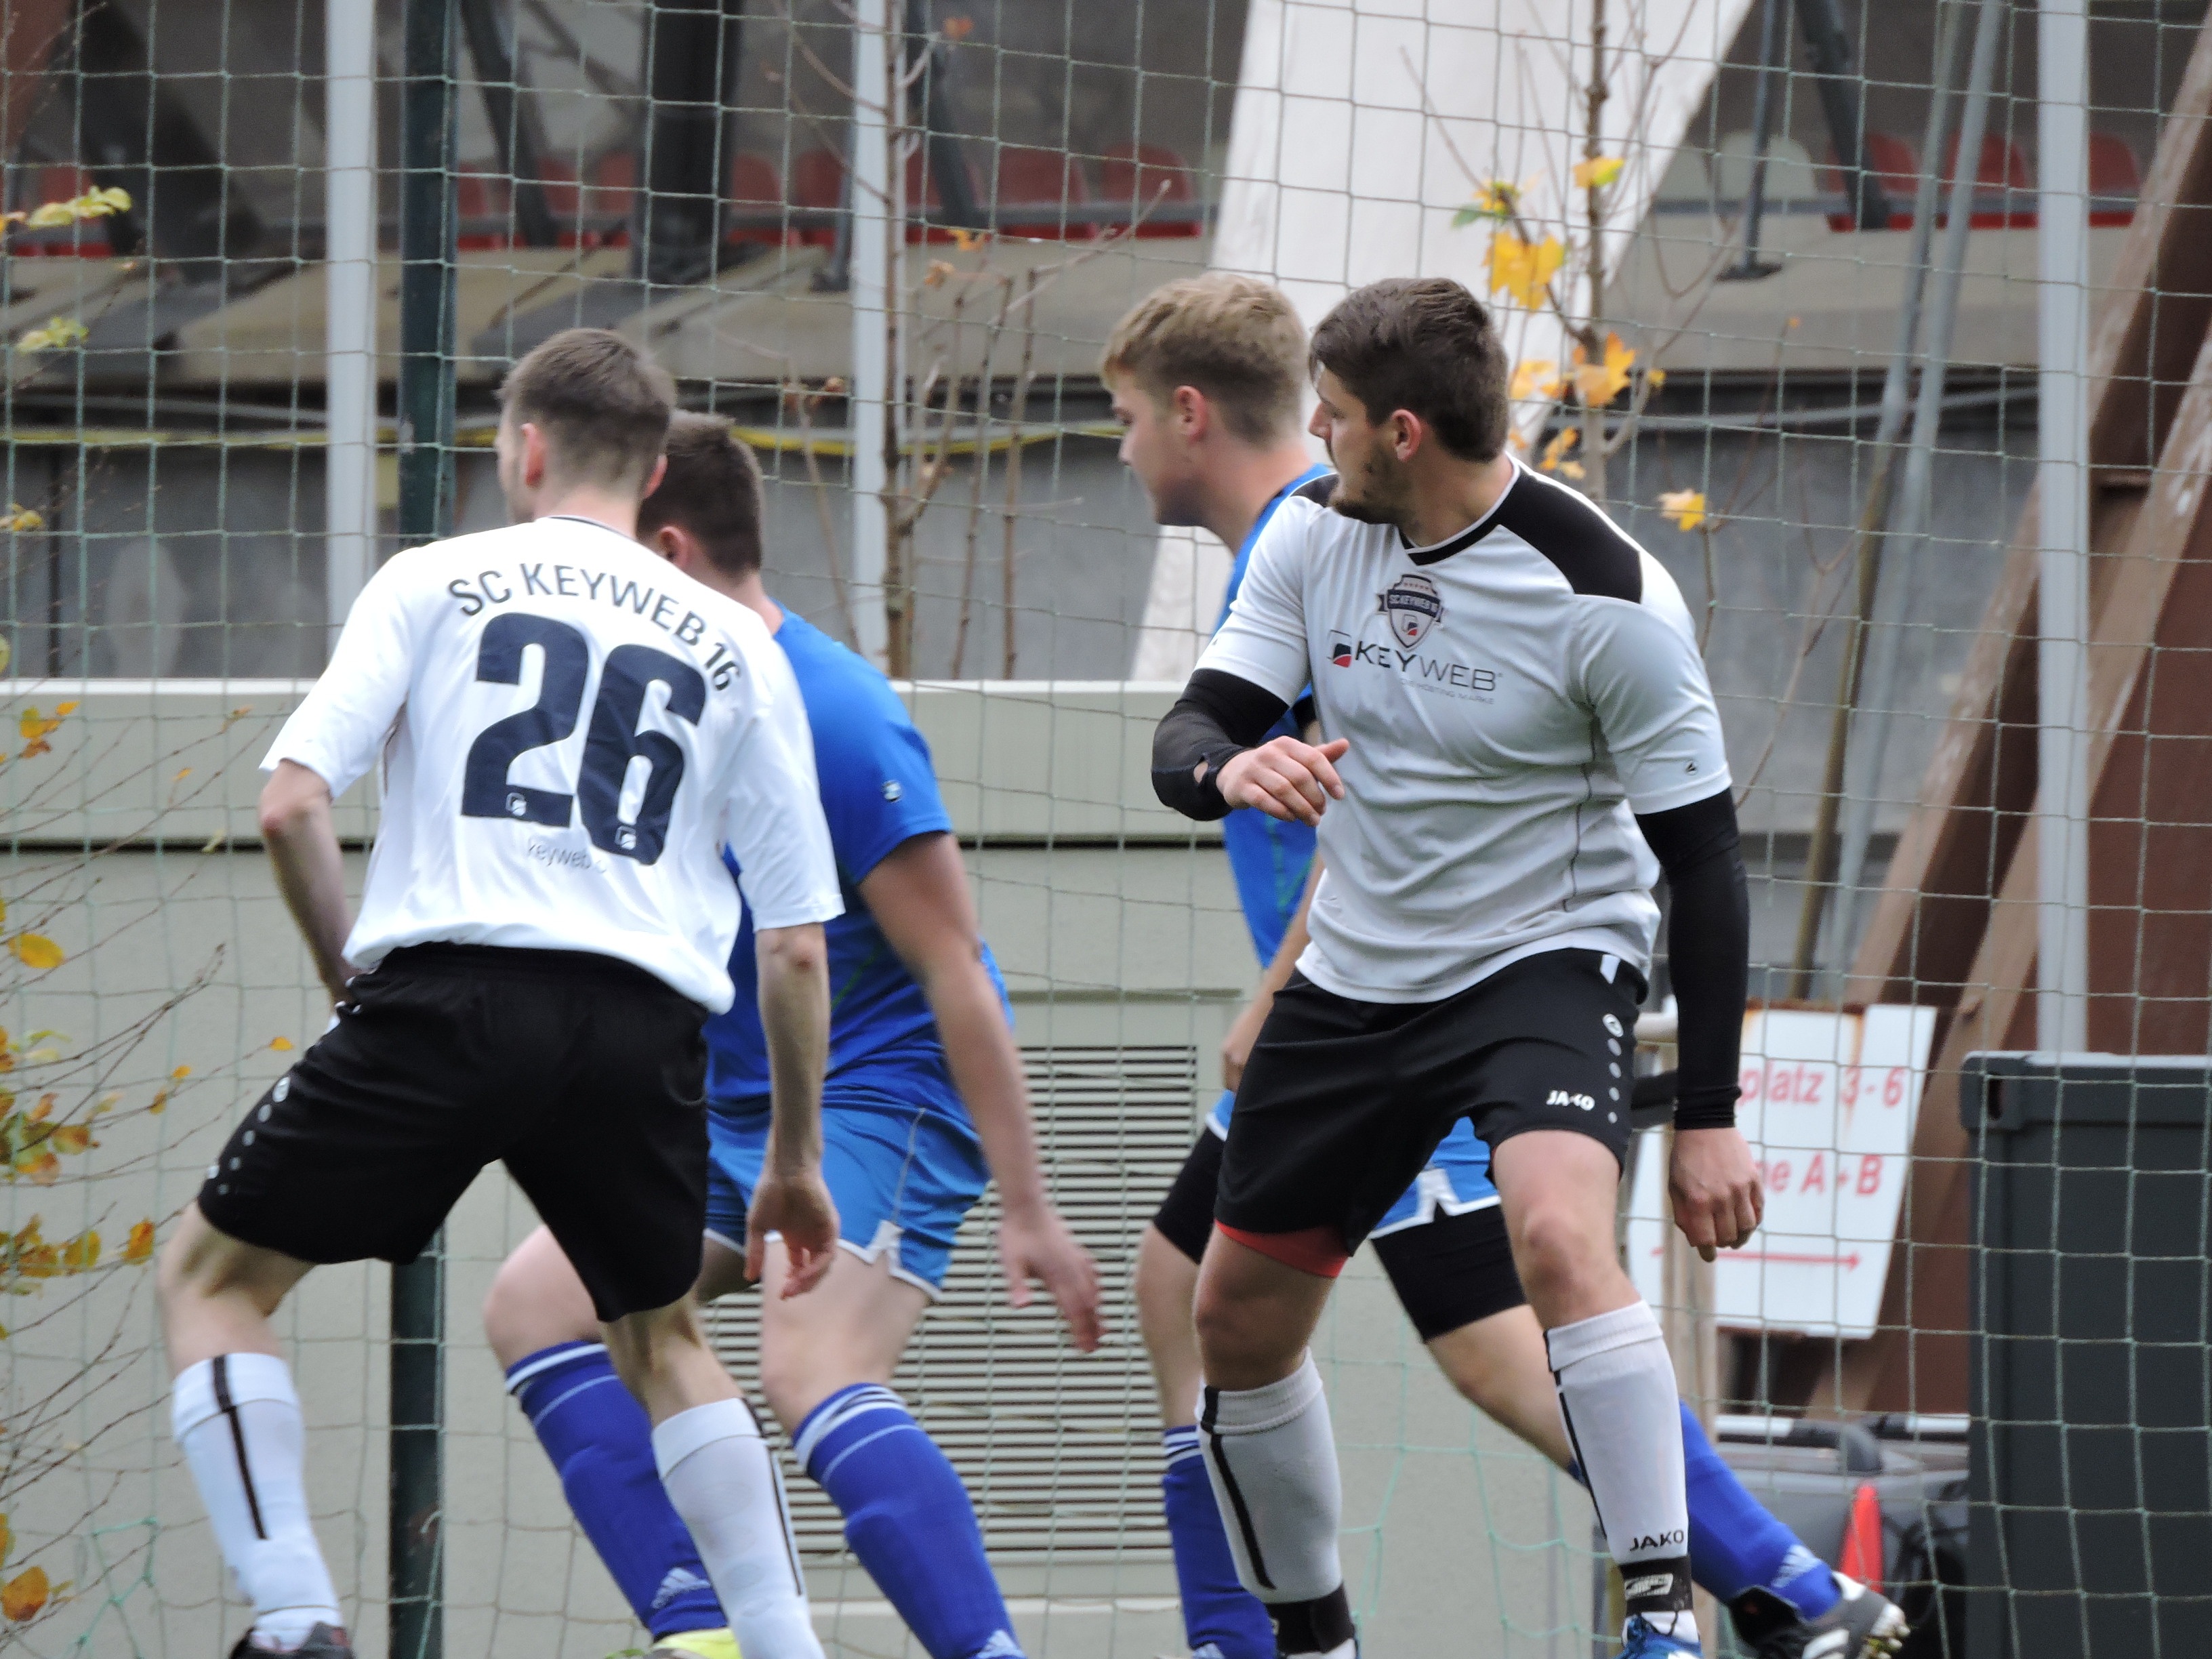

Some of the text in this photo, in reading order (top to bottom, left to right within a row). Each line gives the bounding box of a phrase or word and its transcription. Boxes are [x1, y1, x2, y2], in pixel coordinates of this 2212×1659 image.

[447, 562, 741, 692] SC KEYWEB 16
[461, 611, 707, 866] 26
[1629, 1529, 1685, 1552] JAKO
